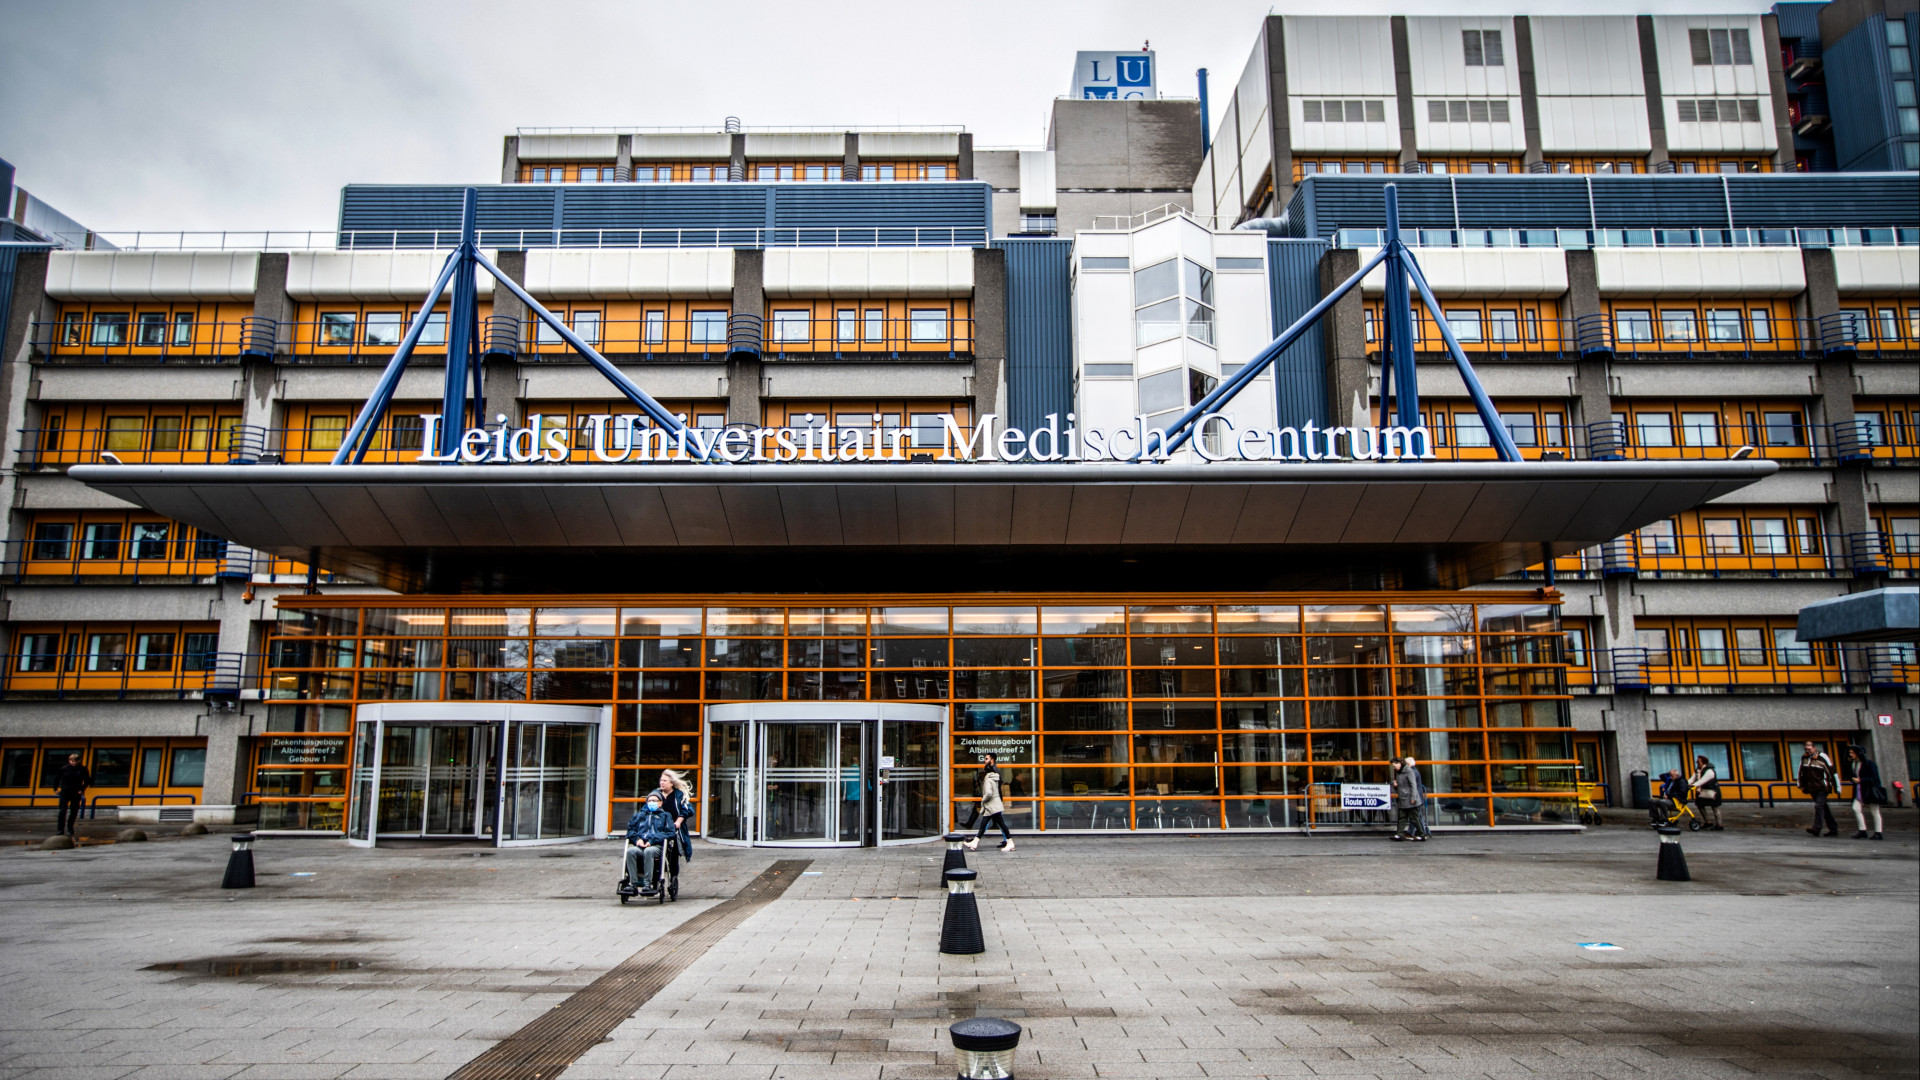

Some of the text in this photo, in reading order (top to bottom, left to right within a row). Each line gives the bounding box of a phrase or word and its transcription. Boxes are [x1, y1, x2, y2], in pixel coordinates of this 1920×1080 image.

[416, 412, 1437, 464] Leids Universitair Medisch Centrum
[273, 739, 344, 748] Ziekenhuisgebouw
[961, 738, 1032, 747] Ziekenhuisgebouw
[969, 746, 1018, 754] Albinusdreef
[289, 755, 320, 763] Gebouw
[1345, 798, 1377, 806] Route 1000
